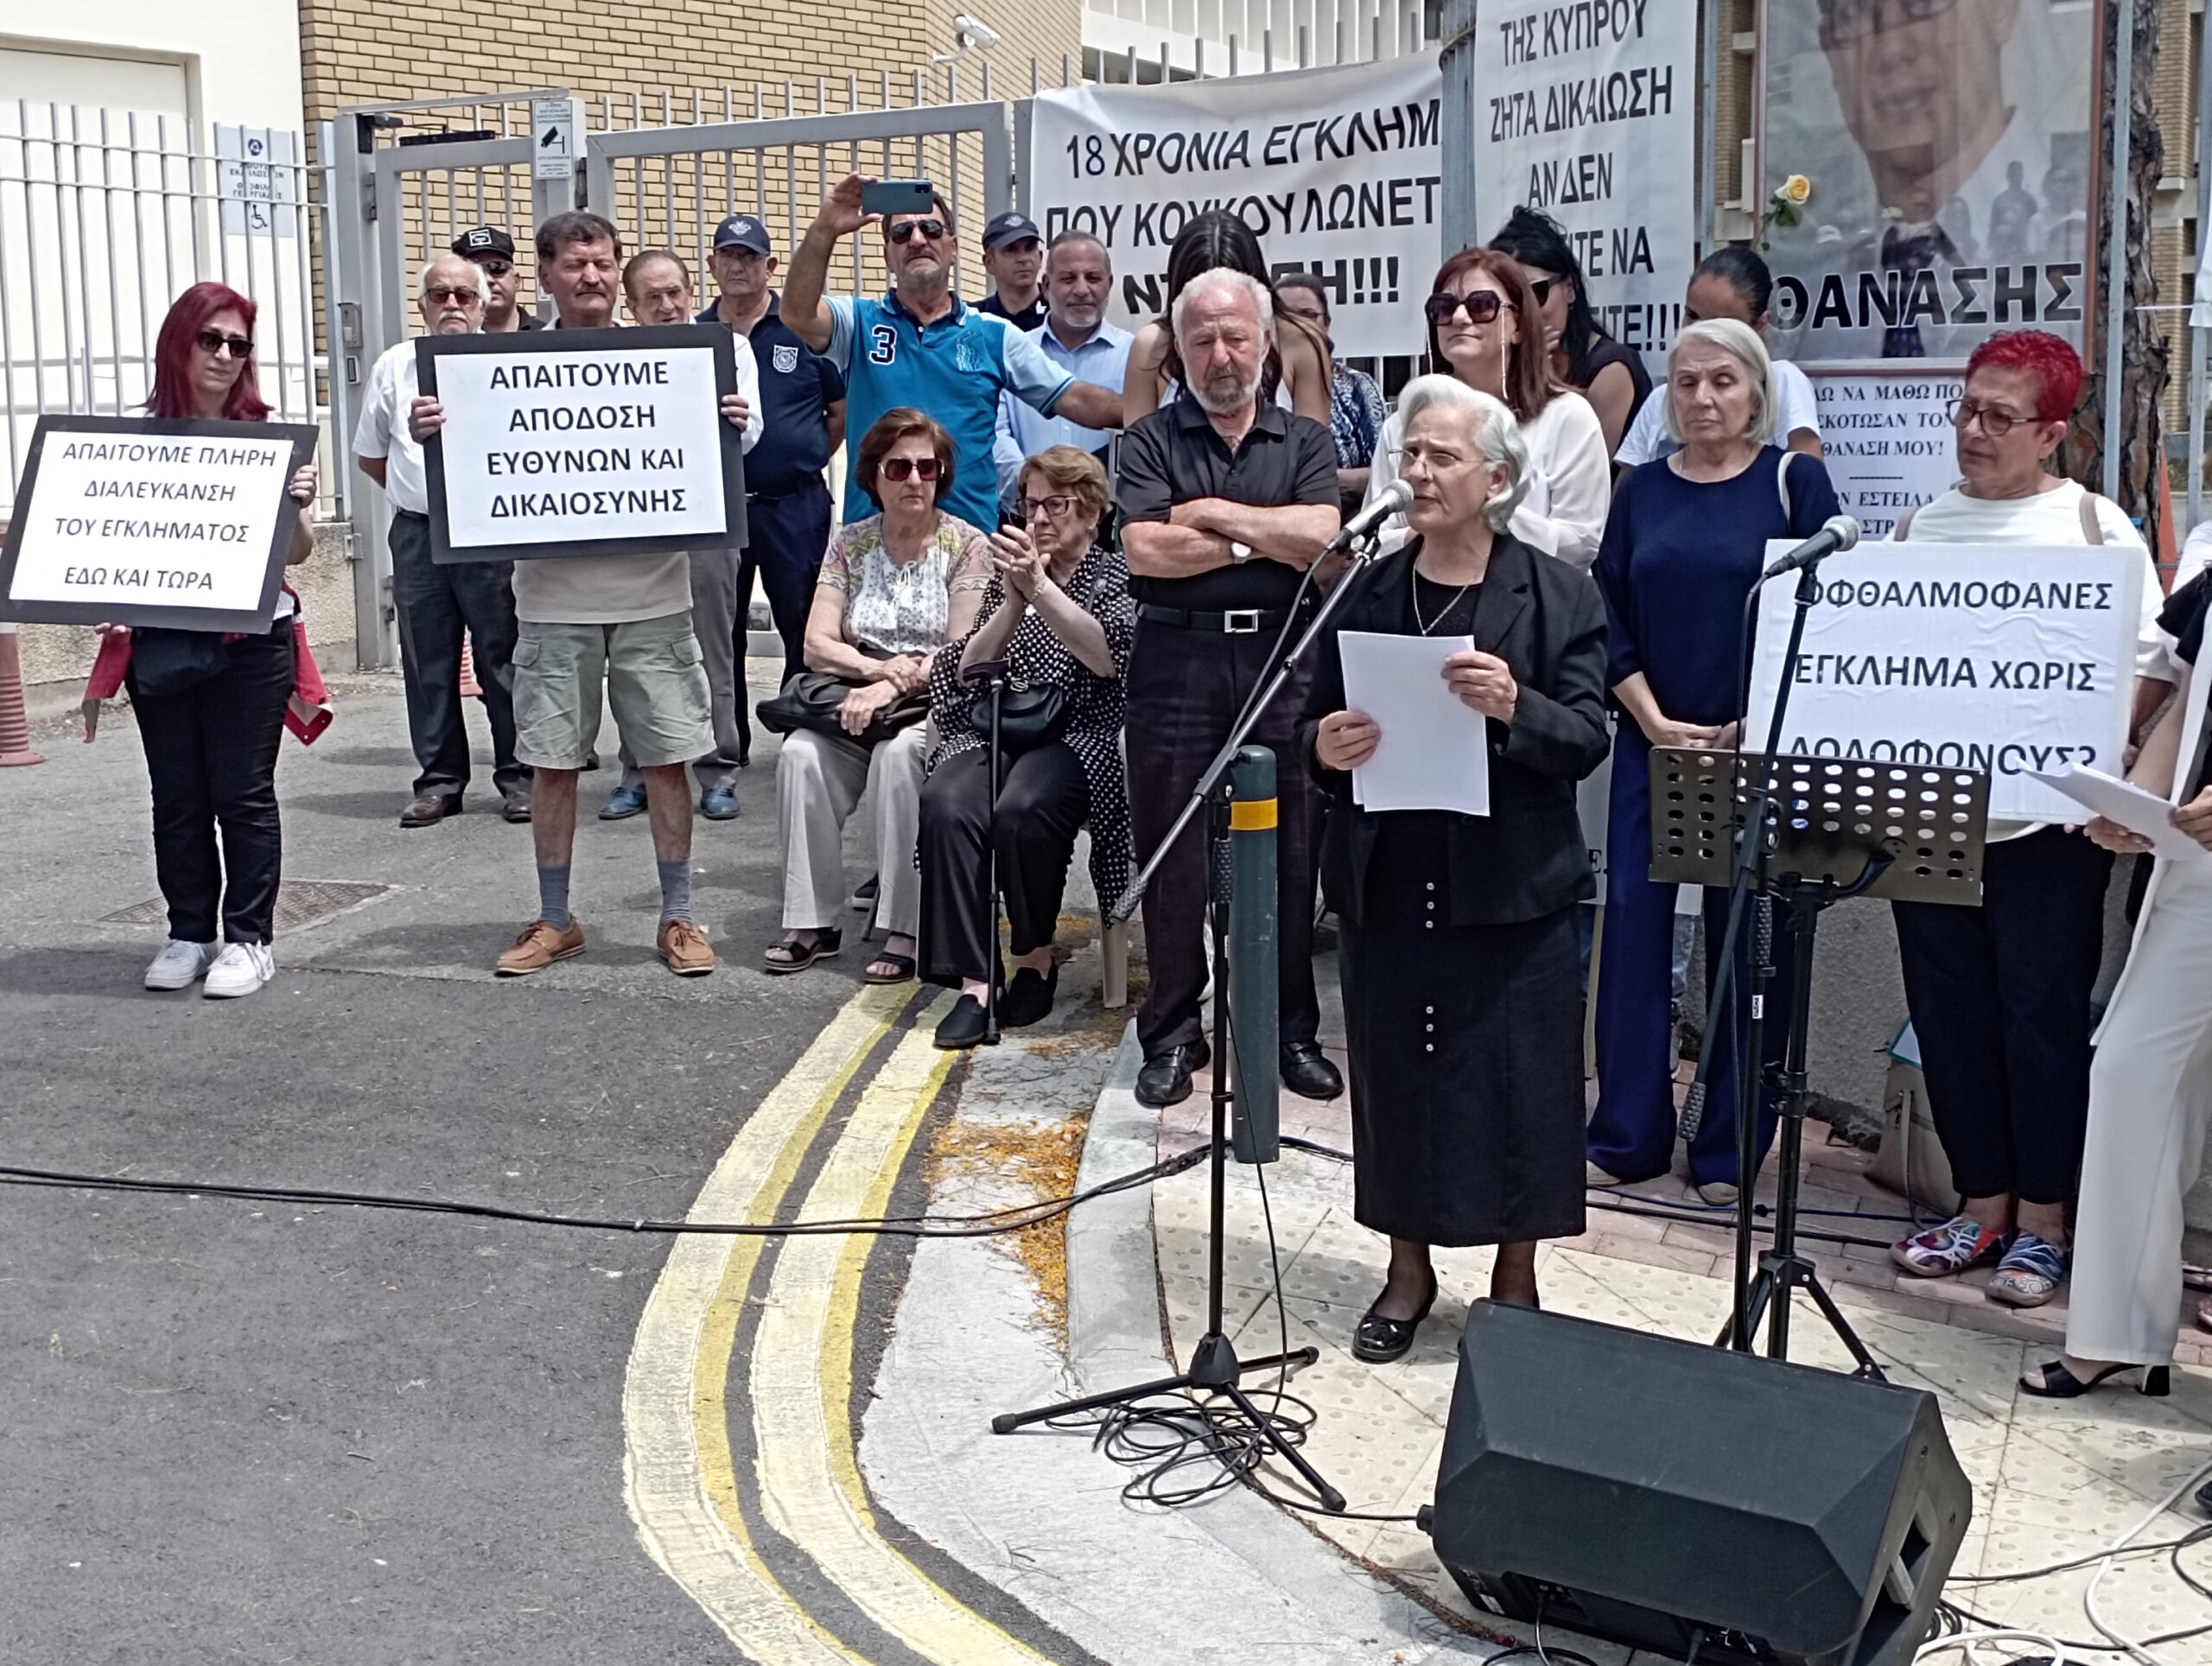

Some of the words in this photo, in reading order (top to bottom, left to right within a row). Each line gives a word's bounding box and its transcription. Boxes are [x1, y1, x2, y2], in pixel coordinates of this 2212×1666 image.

[1501, 15, 1537, 67] ΤΗΣ
[1544, 0, 1646, 57] ΚΥΠΡΟΥ
[1491, 90, 1539, 143] ΖΗΤΑ
[1544, 65, 1672, 132] ΔΙΚΑΙΩΣΗ
[1066, 134, 1106, 180] 18
[1109, 130, 1251, 177] ΧΡΟΝΙΑ
[1263, 99, 1442, 166] ΕΓΚΛΗΜ
[1046, 204, 1124, 250] ΠΟΥ
[1133, 176, 1441, 247] ΚΟΟΥΛΩΝΕΤ
[1611, 226, 1655, 276] ΝΑ
[1769, 262, 2083, 334] ΘΑΝΑΣΗΣ
[868, 324, 897, 365] 3
[490, 361, 670, 390] ΑΠΑΙΤΟΥΜΕ
[1842, 385, 1866, 402] ΝΑ
[1874, 385, 1929, 400] ΜΑΘΩ
[1936, 384, 1964, 399] ΠΟ
[509, 404, 657, 432] ΑΠΟΔΟΣΗ
[62, 443, 193, 463] ΑΠΑΙΤΟΥΜΕ
[199, 448, 277, 467] ΠΛΗΡΗ
[486, 448, 631, 475] ΕΥΘΥΝΩΝ
[642, 448, 684, 470] ΚΑΙ
[1822, 441, 1889, 456] ΘΑΝΑΣΗ
[1894, 440, 1944, 456] ΜΟΥ!
[84, 480, 236, 502] ΔΙΑΛΕΥΚΑΝΣΗ
[491, 489, 688, 518] ΔΙΚΑΙΟΣΥΝΗΣ
[55, 518, 97, 536] ΤΟΥ
[101, 520, 250, 543] ΕΓΚΛΗΜΑΤΟΣ
[1862, 519, 1895, 534] ΣΤΡ
[64, 567, 106, 585] ΕΔΩ
[112, 569, 149, 587] ΚΑΙ
[156, 570, 213, 590] ΤΩΡΑ
[1795, 653, 1979, 690] ΕΓΚΛΗΜΑ
[1989, 660, 2097, 692] ΧΩΡΙΣ
